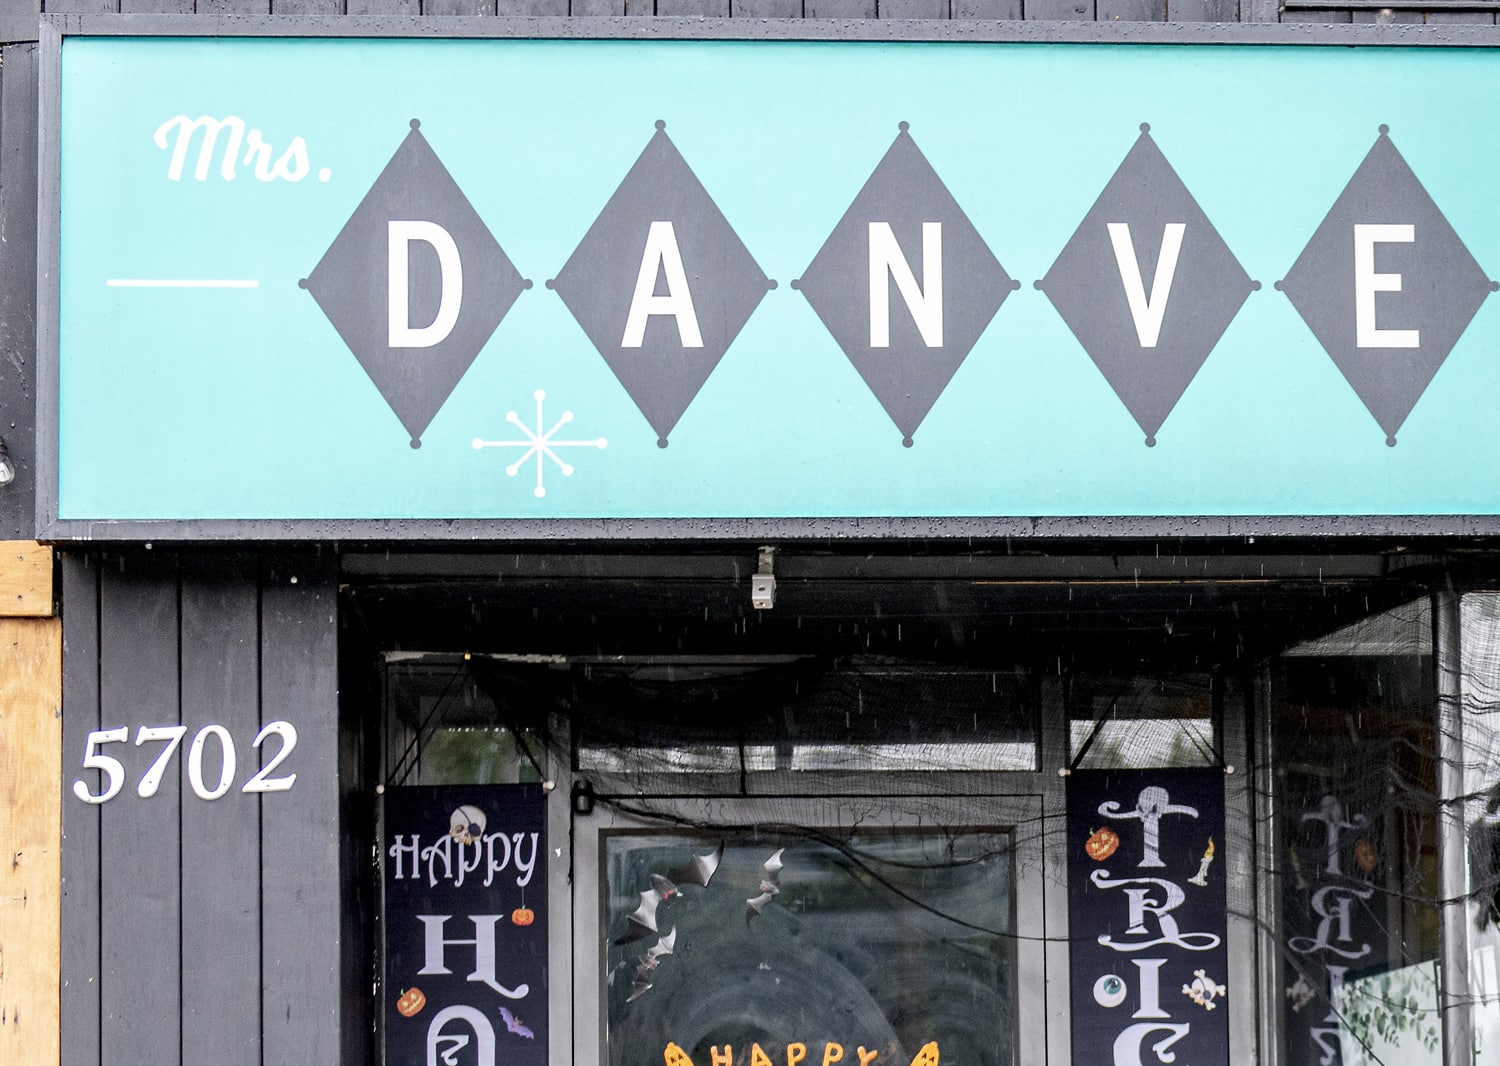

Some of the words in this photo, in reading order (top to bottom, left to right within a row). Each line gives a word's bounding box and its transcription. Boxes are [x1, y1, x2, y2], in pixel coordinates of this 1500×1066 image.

[153, 114, 332, 183] Mrs.
[73, 720, 298, 804] 5702
[389, 829, 540, 887] HAPPY
